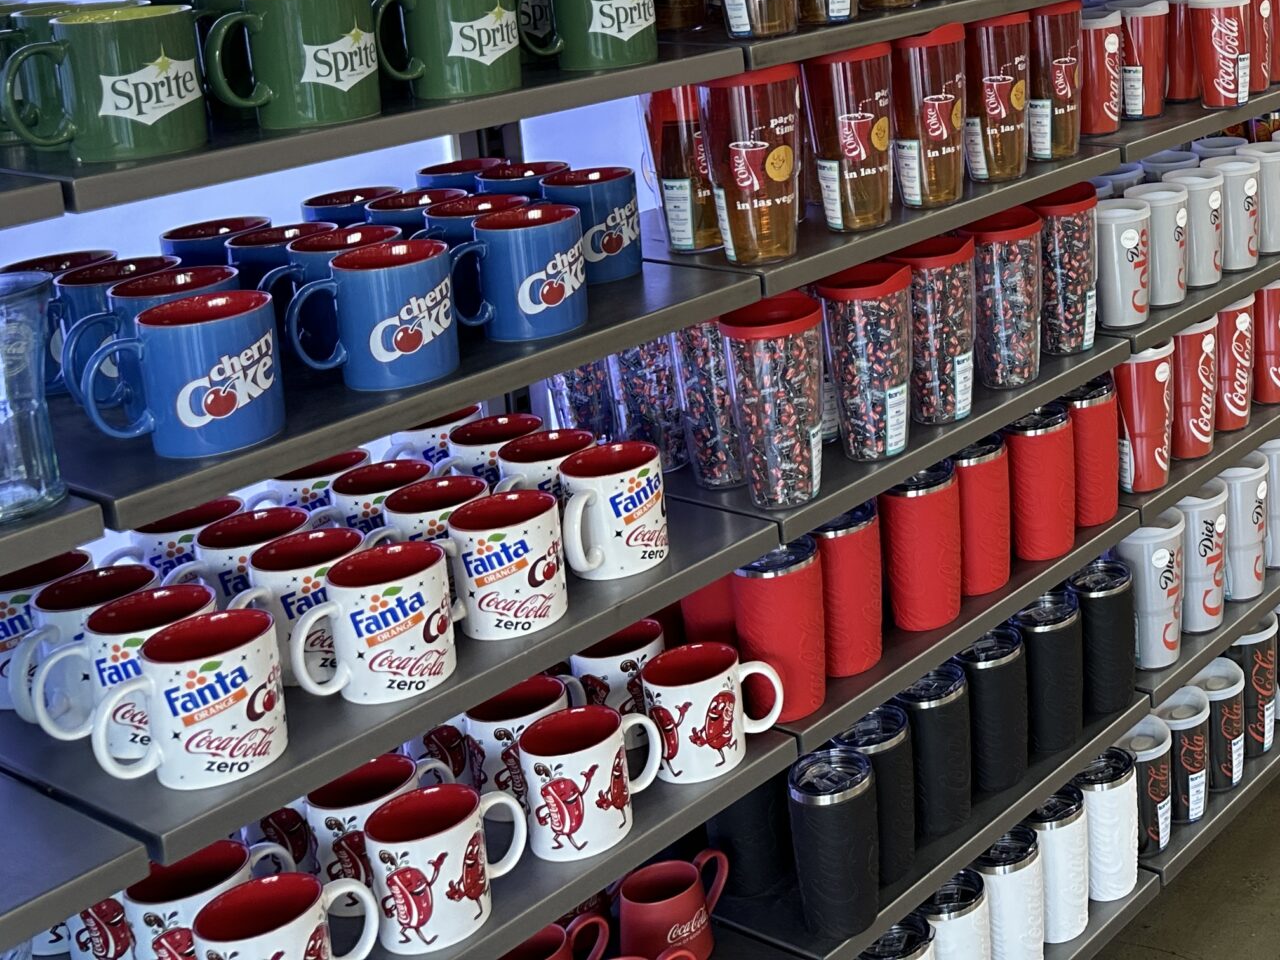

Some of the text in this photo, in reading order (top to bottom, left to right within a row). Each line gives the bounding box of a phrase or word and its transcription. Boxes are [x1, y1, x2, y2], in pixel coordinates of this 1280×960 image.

[460, 20, 517, 56] Sprite
[1212, 11, 1239, 99] Coca-Cola
[313, 42, 377, 82] Sprite
[111, 69, 195, 115] Sprite
[733, 155, 753, 188] Coke
[775, 193, 794, 206] vega
[369, 299, 452, 363] Coke
[211, 328, 273, 381] cherry
[176, 356, 275, 428] Coke
[609, 472, 661, 519] Fanta
[641, 549, 665, 560] zero
[1199, 519, 1215, 558] Diet
[462, 539, 531, 578] Fanta
[484, 564, 519, 585] ORANGE
[350, 591, 426, 639] Fanta
[478, 591, 557, 619] Coca-Cola
[377, 618, 415, 642] ORANGE
[495, 618, 532, 631] zero
[368, 648, 448, 677] Coca-Cola
[164, 665, 250, 718] Fanta
[387, 678, 426, 691] zero
[194, 695, 239, 723] ORANGE
[185, 725, 277, 759] Coca-Cola
[205, 759, 250, 773] zero
